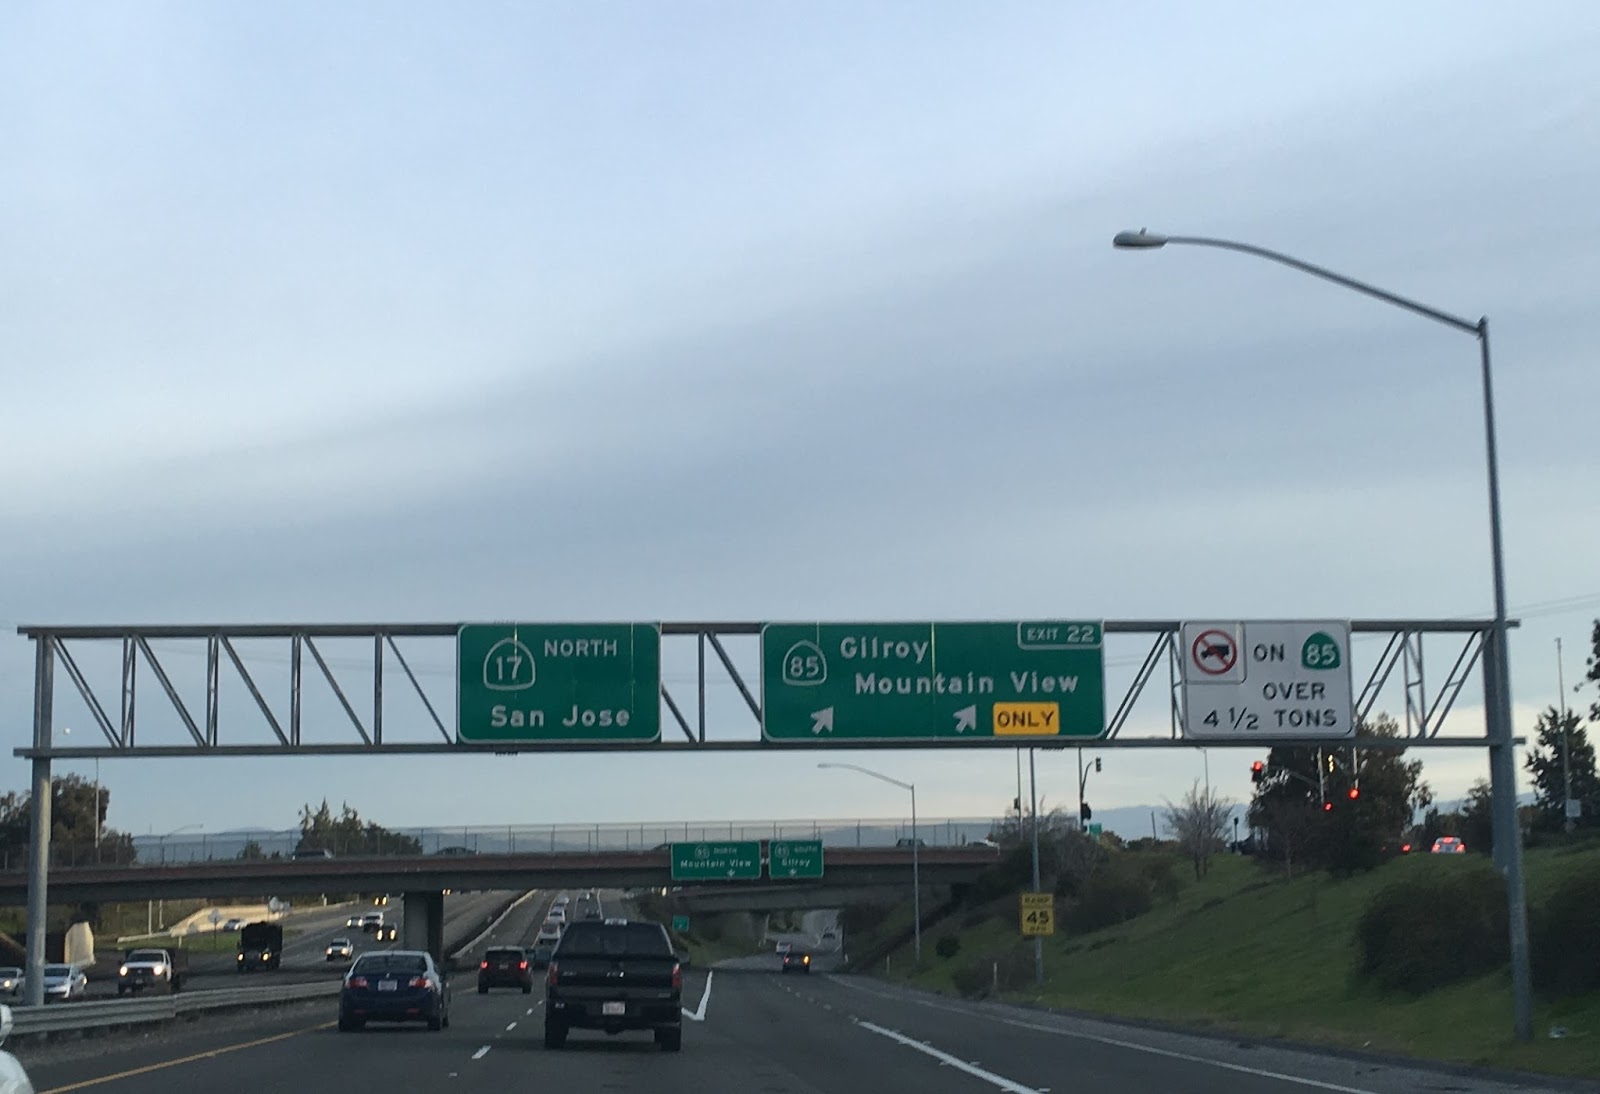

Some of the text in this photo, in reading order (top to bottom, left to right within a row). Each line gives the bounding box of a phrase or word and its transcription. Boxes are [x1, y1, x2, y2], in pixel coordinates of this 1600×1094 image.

[1026, 625, 1095, 643] EXIT 22
[544, 639, 618, 658] NORTH
[840, 636, 929, 664] Gilroy
[1253, 643, 1285, 662] ON
[1306, 643, 1337, 666] 85
[495, 655, 523, 681] 17
[789, 656, 820, 678] 85
[855, 671, 1079, 695] Mountain View
[1262, 682, 1326, 701] OVER
[490, 704, 631, 728] San Jose
[997, 710, 1055, 728] ONLY
[1273, 708, 1338, 728] TONS
[680, 858, 752, 869] Mountain View
[781, 857, 811, 868] Gilroy
[1026, 910, 1050, 925] 45
